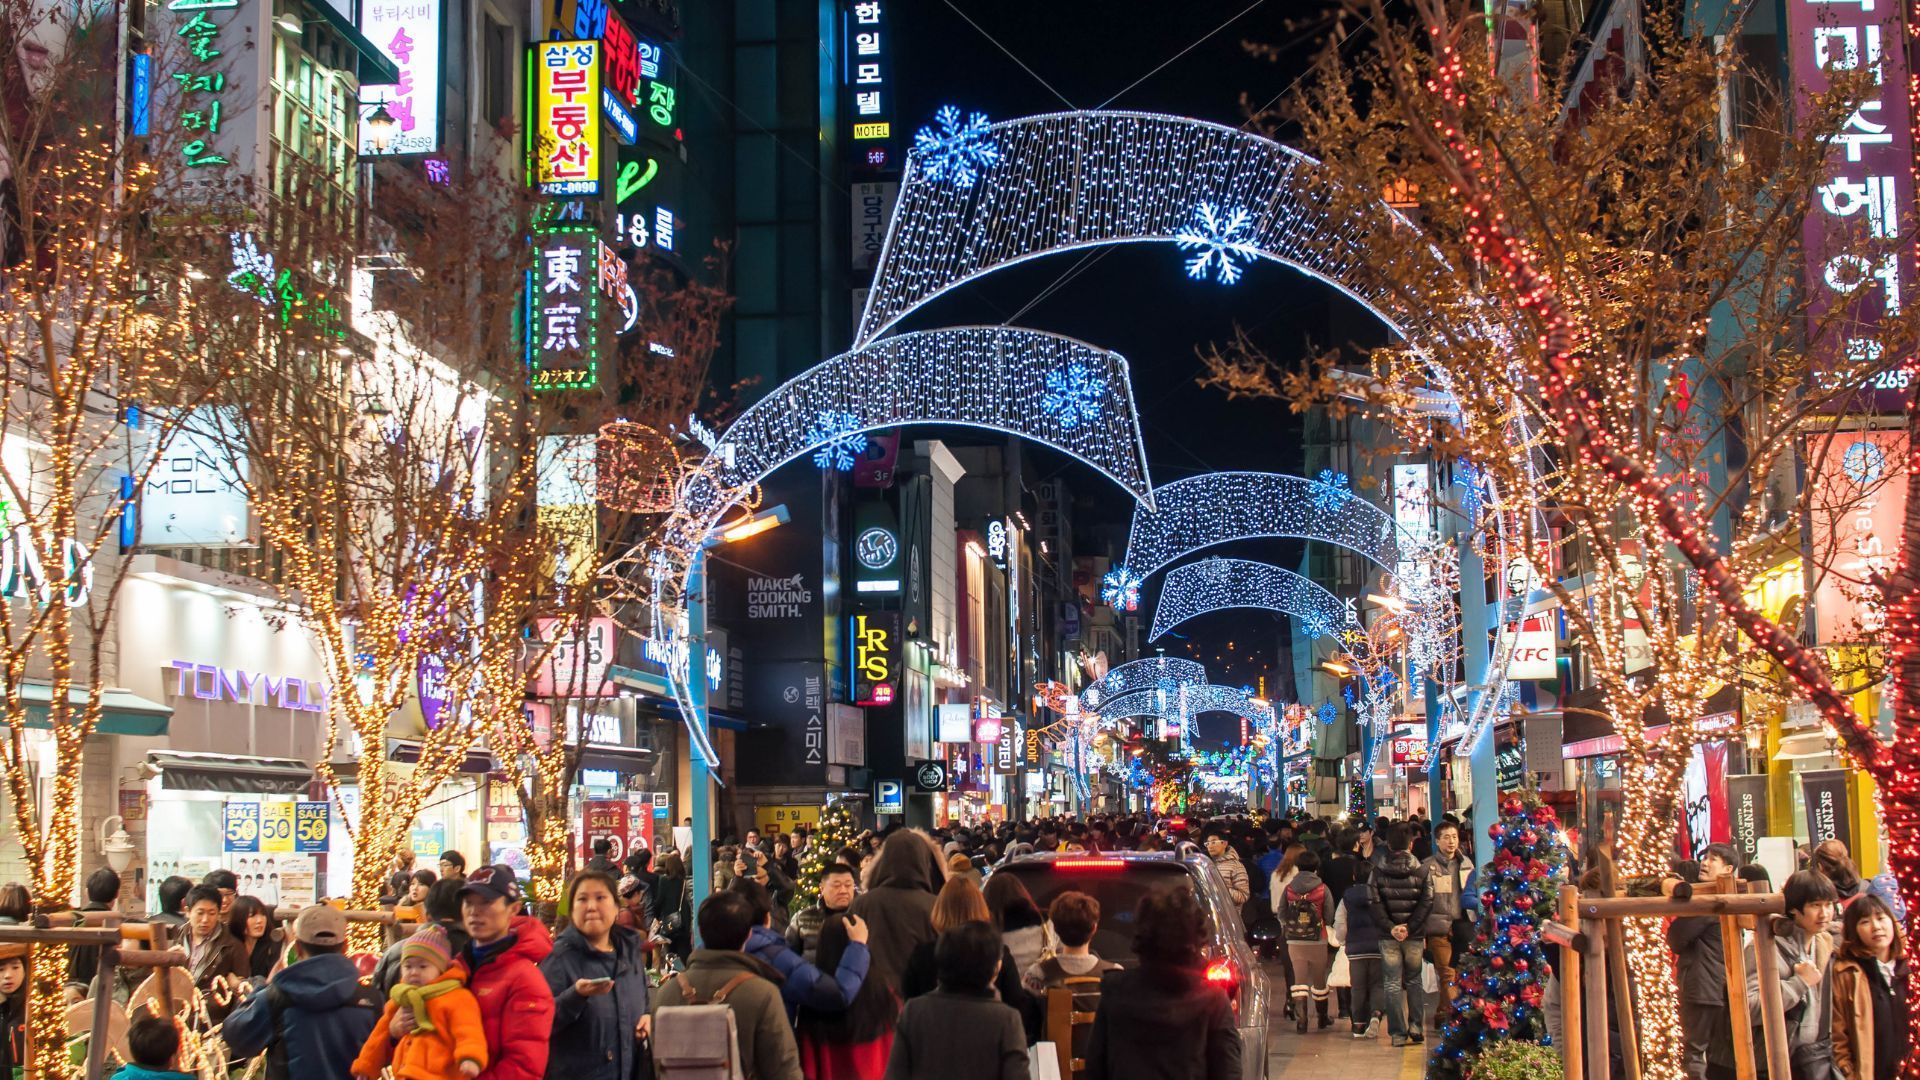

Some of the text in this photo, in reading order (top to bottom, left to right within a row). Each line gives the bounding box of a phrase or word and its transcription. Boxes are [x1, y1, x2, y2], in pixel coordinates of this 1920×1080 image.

[546, 45, 593, 66] 삼성
[855, 1, 882, 115] 한일모텔
[551, 70, 590, 178] 부동산
[856, 125, 888, 137] MOTEL
[868, 152, 885, 164] 5-6F
[541, 181, 596, 194] 242-0090
[863, 196, 883, 251] 당구장
[543, 246, 582, 352] 東京
[874, 470, 889, 482] 3F
[748, 578, 791, 591] MAKE
[748, 591, 812, 605] COOKING
[1345, 597, 1357, 624] KB
[856, 615, 889, 681] IRIS
[1508, 647, 1549, 662] KFC
[805, 675, 822, 765] 블랙스미스
[999, 725, 1011, 770] A'PIEU
[1027, 728, 1039, 763] espoir
[878, 781, 899, 803] P
[227, 810, 258, 819] SALE
[298, 810, 327, 819] SALE
[591, 816, 620, 827] SALE
[776, 810, 801, 821] 한일
[1742, 793, 1755, 853] SKINFOOD
[1820, 791, 1836, 842] SKINFO
